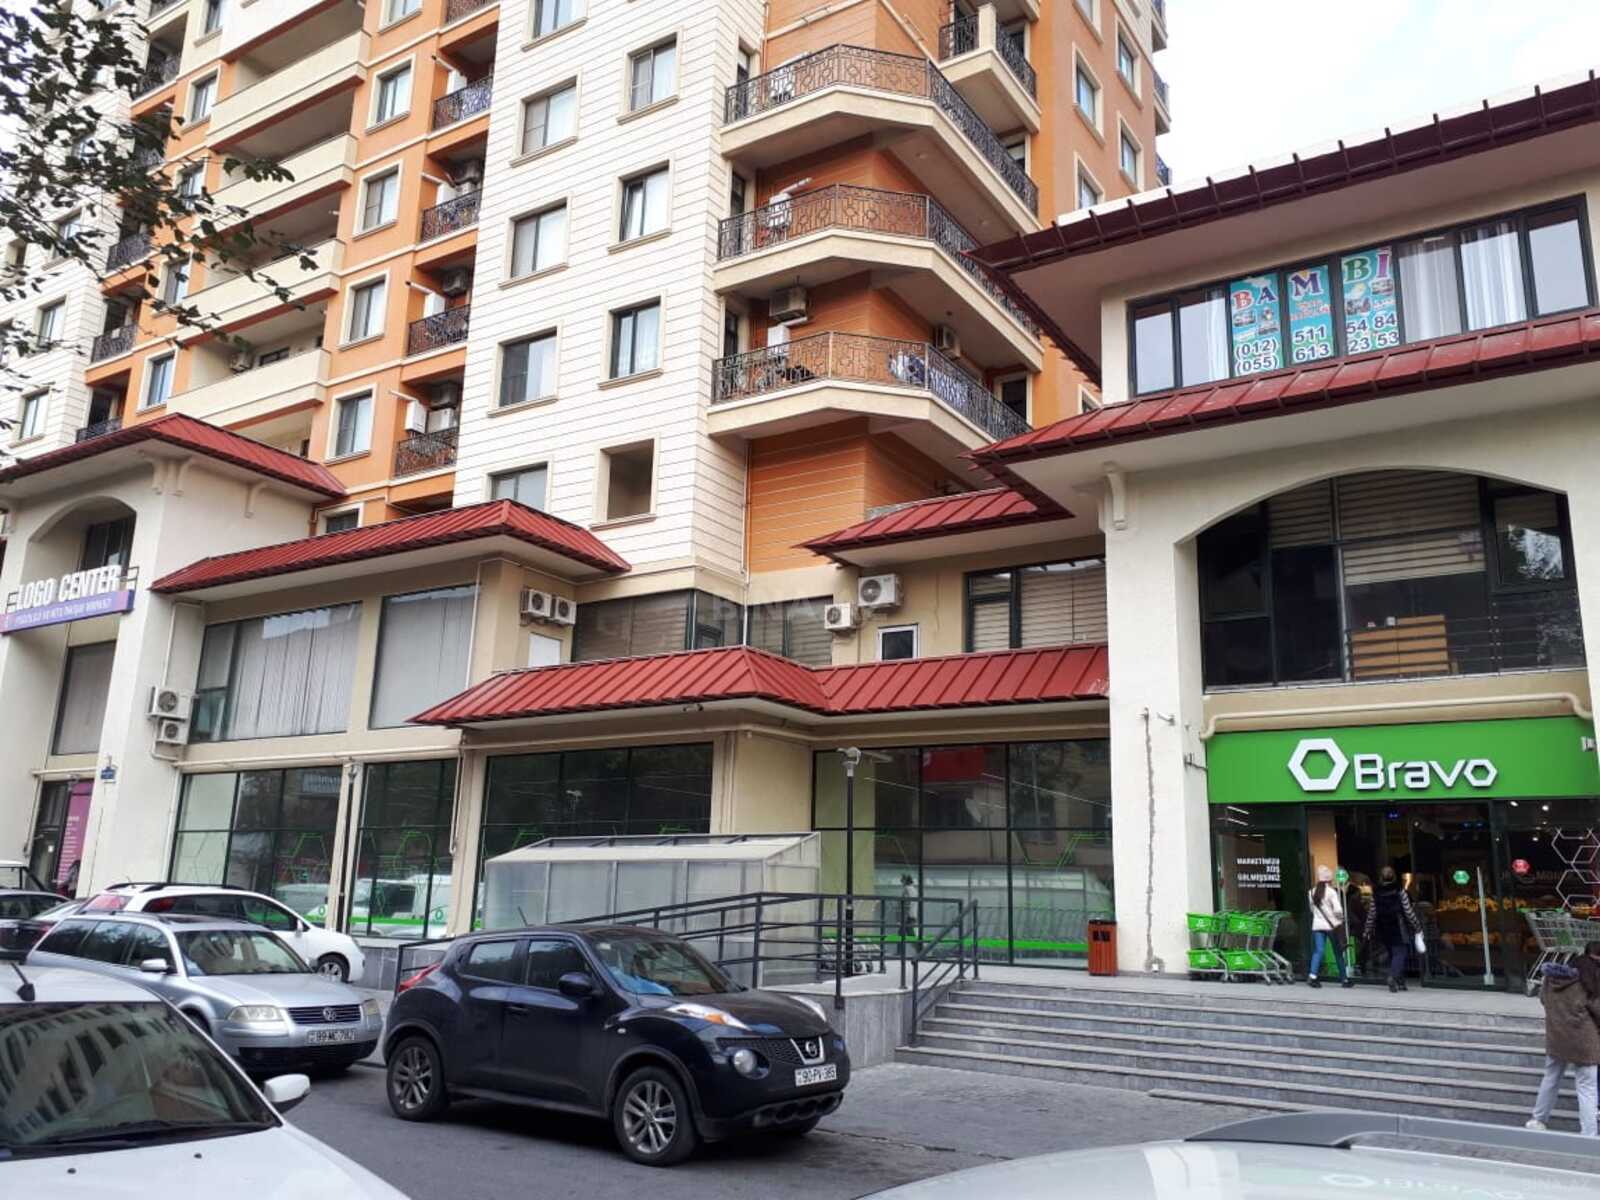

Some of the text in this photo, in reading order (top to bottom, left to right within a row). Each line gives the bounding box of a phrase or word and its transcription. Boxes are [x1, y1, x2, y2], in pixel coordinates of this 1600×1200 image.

[1235, 313, 1397, 358] (012) 511 54 84
[1235, 331, 1399, 375] (055) 613 23 53
[17, 564, 122, 610] LOGO CENTER
[1353, 753, 1499, 791] Bravo
